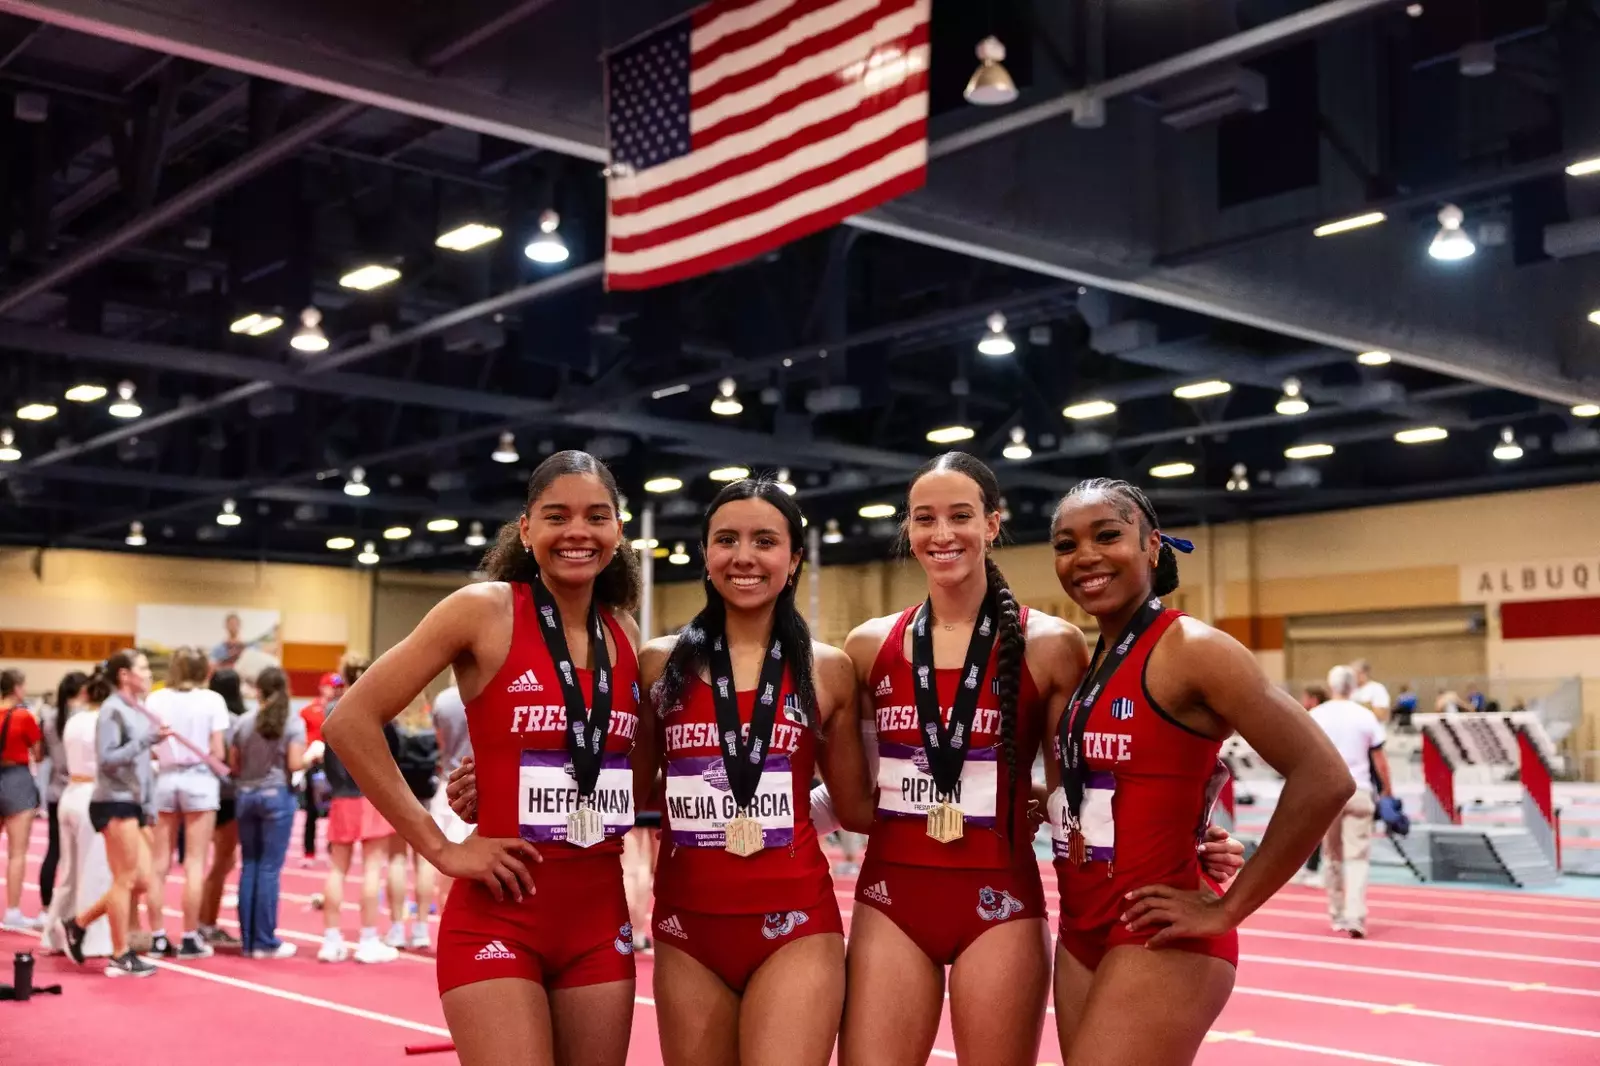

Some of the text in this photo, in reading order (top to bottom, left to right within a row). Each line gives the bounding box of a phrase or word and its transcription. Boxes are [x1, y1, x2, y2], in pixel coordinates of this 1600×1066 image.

[1477, 563, 1600, 594] ALBUQ
[507, 682, 544, 693] adidas
[510, 704, 592, 733] FRES
[608, 709, 639, 740] STAT
[876, 704, 1003, 736] FRES SAT
[665, 722, 802, 752] FRESN STE
[1068, 731, 1133, 761] TATE
[668, 795, 718, 820] MEJIA
[863, 888, 892, 905] adidas
[658, 922, 688, 939] adidas
[474, 951, 516, 961] adidas
